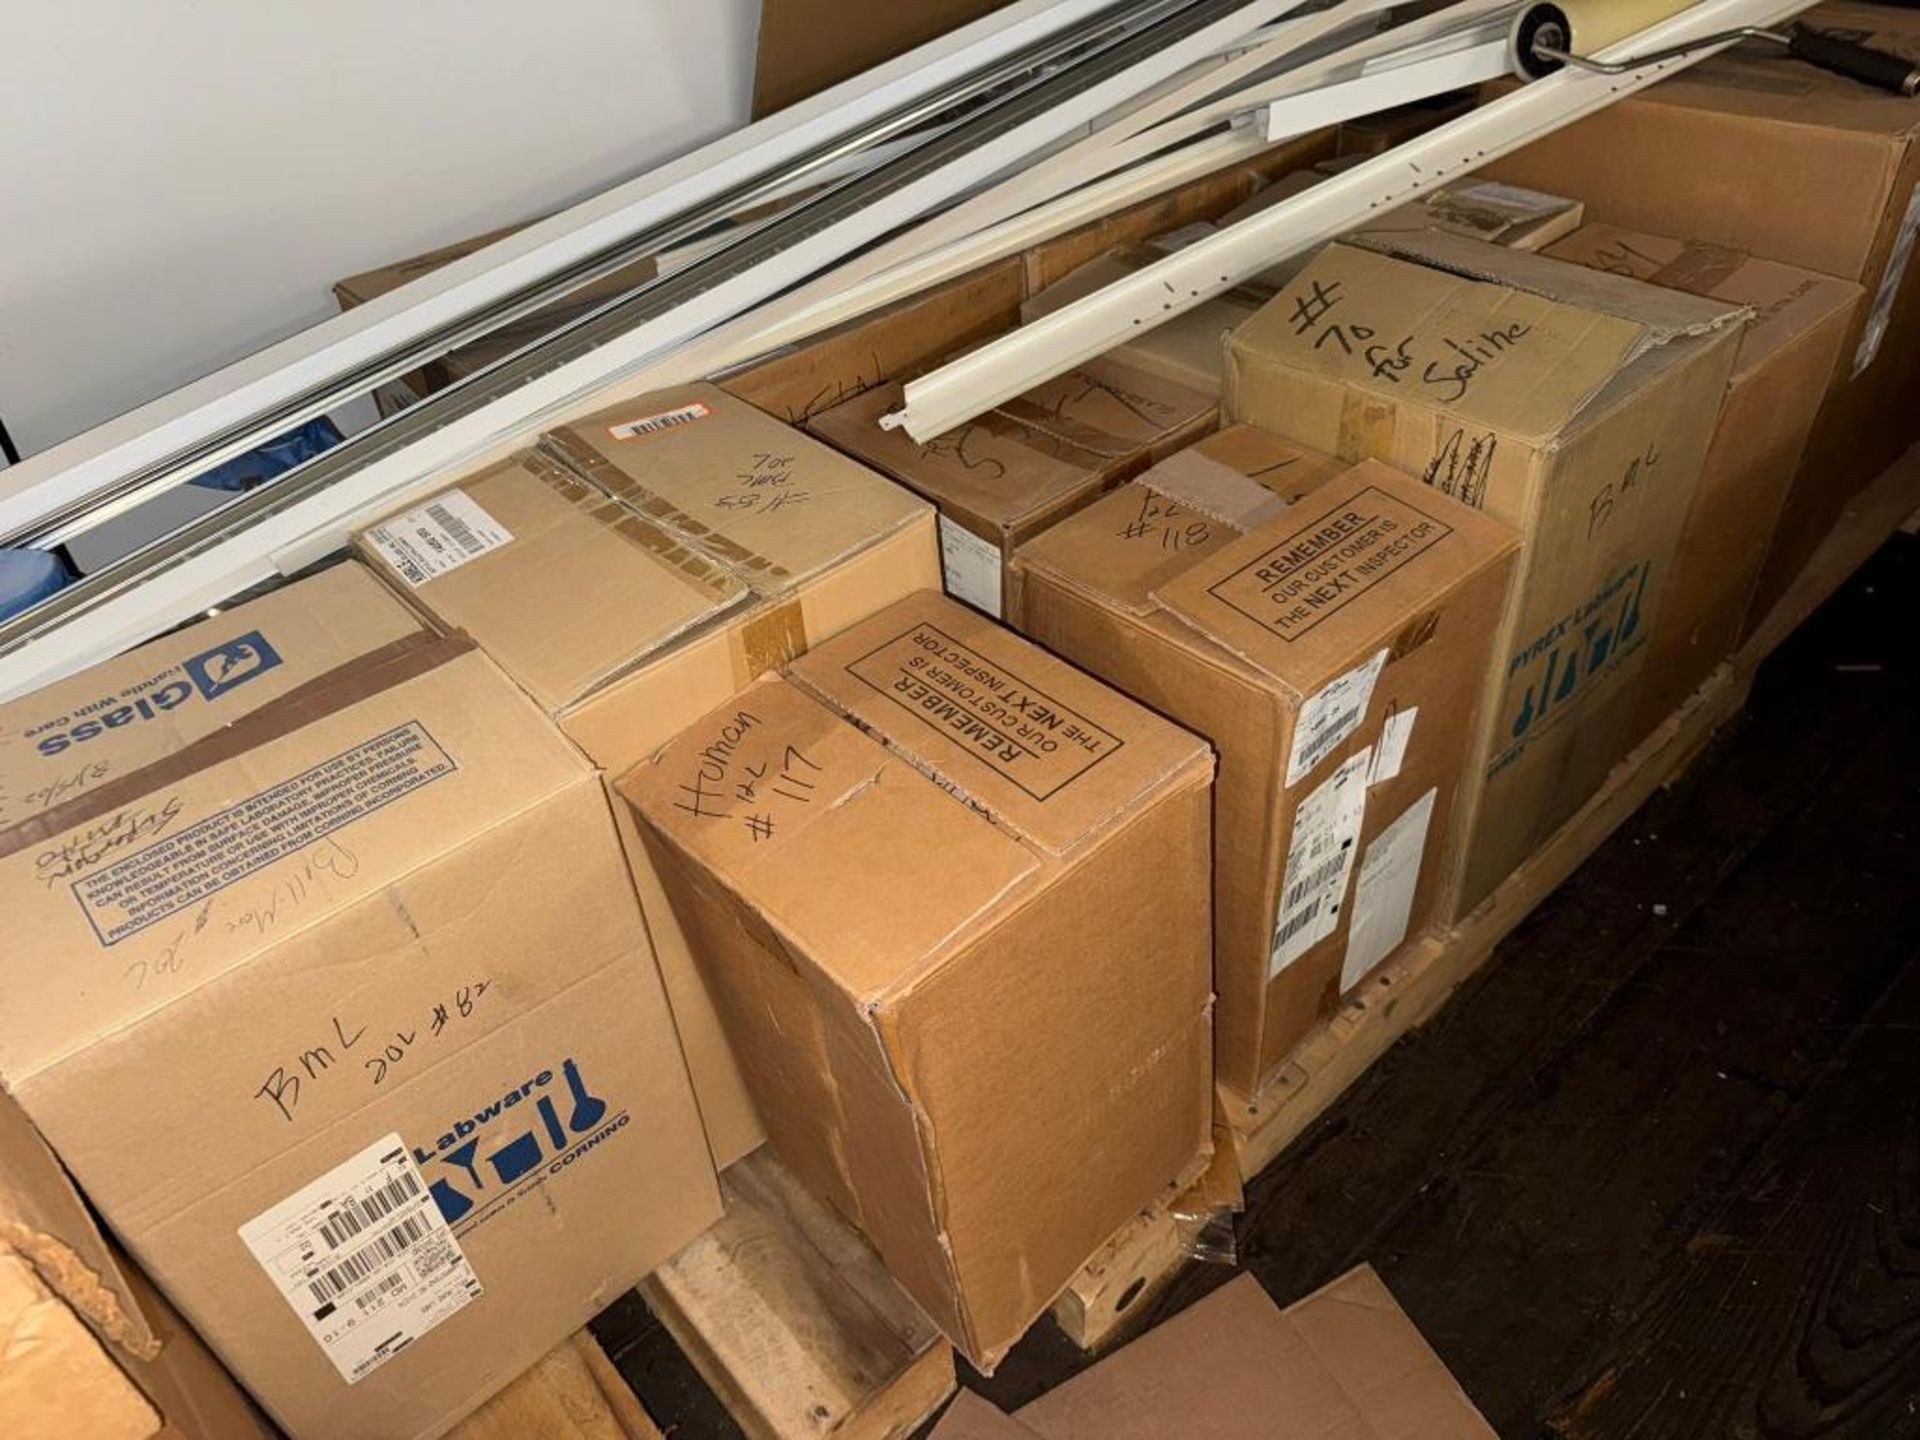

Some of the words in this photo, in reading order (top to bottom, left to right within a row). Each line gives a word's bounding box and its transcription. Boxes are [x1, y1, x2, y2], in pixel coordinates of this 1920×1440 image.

[1289, 280, 1341, 335] #
[1314, 322, 1374, 357] 70
[1423, 319, 1533, 402] Saline
[1253, 511, 1367, 583] REMEMBER
[1268, 579, 1309, 605] OUR
[1301, 529, 1385, 583] CUSTOMER
[1377, 519, 1399, 533] IS
[1273, 605, 1312, 630] THE
[1301, 569, 1362, 609] NEXT
[1352, 521, 1437, 576] INSPECTOR
[906, 655, 930, 670] IS
[909, 632, 1006, 692] INSPECTOR
[923, 666, 1021, 728] CUSTOMER
[24, 717, 70, 738] Care
[37, 681, 193, 756] Glass
[74, 696, 118, 717] With
[889, 675, 1023, 763] REMEMBER
[995, 686, 1065, 730] NEXT
[1014, 723, 1061, 754] OUR
[1060, 724, 1104, 752] THE
[86, 844, 194, 900] KNOWLEDGEABLE
[194, 837, 208, 847] IN
[208, 822, 239, 841] SAFE
[239, 785, 315, 826] LABORATORY
[87, 874, 108, 889] THE
[111, 842, 176, 877] ENCLOSED
[176, 815, 232, 845] PRODUCT
[232, 809, 245, 818] IS
[244, 781, 299, 811] INTENDED
[299, 770, 323, 785] FOR
[322, 759, 345, 774] USE
[346, 751, 362, 762] BY
[362, 728, 411, 754] PERSONS
[94, 889, 123, 908] CAN
[123, 866, 170, 894] RESULT
[170, 848, 207, 870] FROM
[206, 822, 261, 853] SURFACE
[312, 769, 368, 800] IMPROPER
[367, 742, 423, 773] PRESSURE
[127, 870, 210, 916] INFORMATION
[209, 832, 287, 875] CONCERNING
[285, 798, 354, 837] LIMITATIONS
[353, 790, 371, 802] OF
[370, 766, 419, 794] CORNING
[106, 900, 175, 939] PRODUCTS
[174, 886, 203, 904] CAN
[202, 876, 222, 890] BE
[220, 847, 281, 881] OBTAINED
[279, 829, 313, 851] FROM
[313, 804, 364, 834] CORNING
[117, 894, 138, 909] OR
[139, 851, 225, 898] TEMPERATURE
[225, 842, 244, 855] OR
[244, 829, 270, 846] USE
[268, 814, 298, 833] WITH
[298, 787, 355, 819] IMPROPER
[414, 1067, 554, 1164] Labware
[548, 1114, 631, 1174] CORNING
